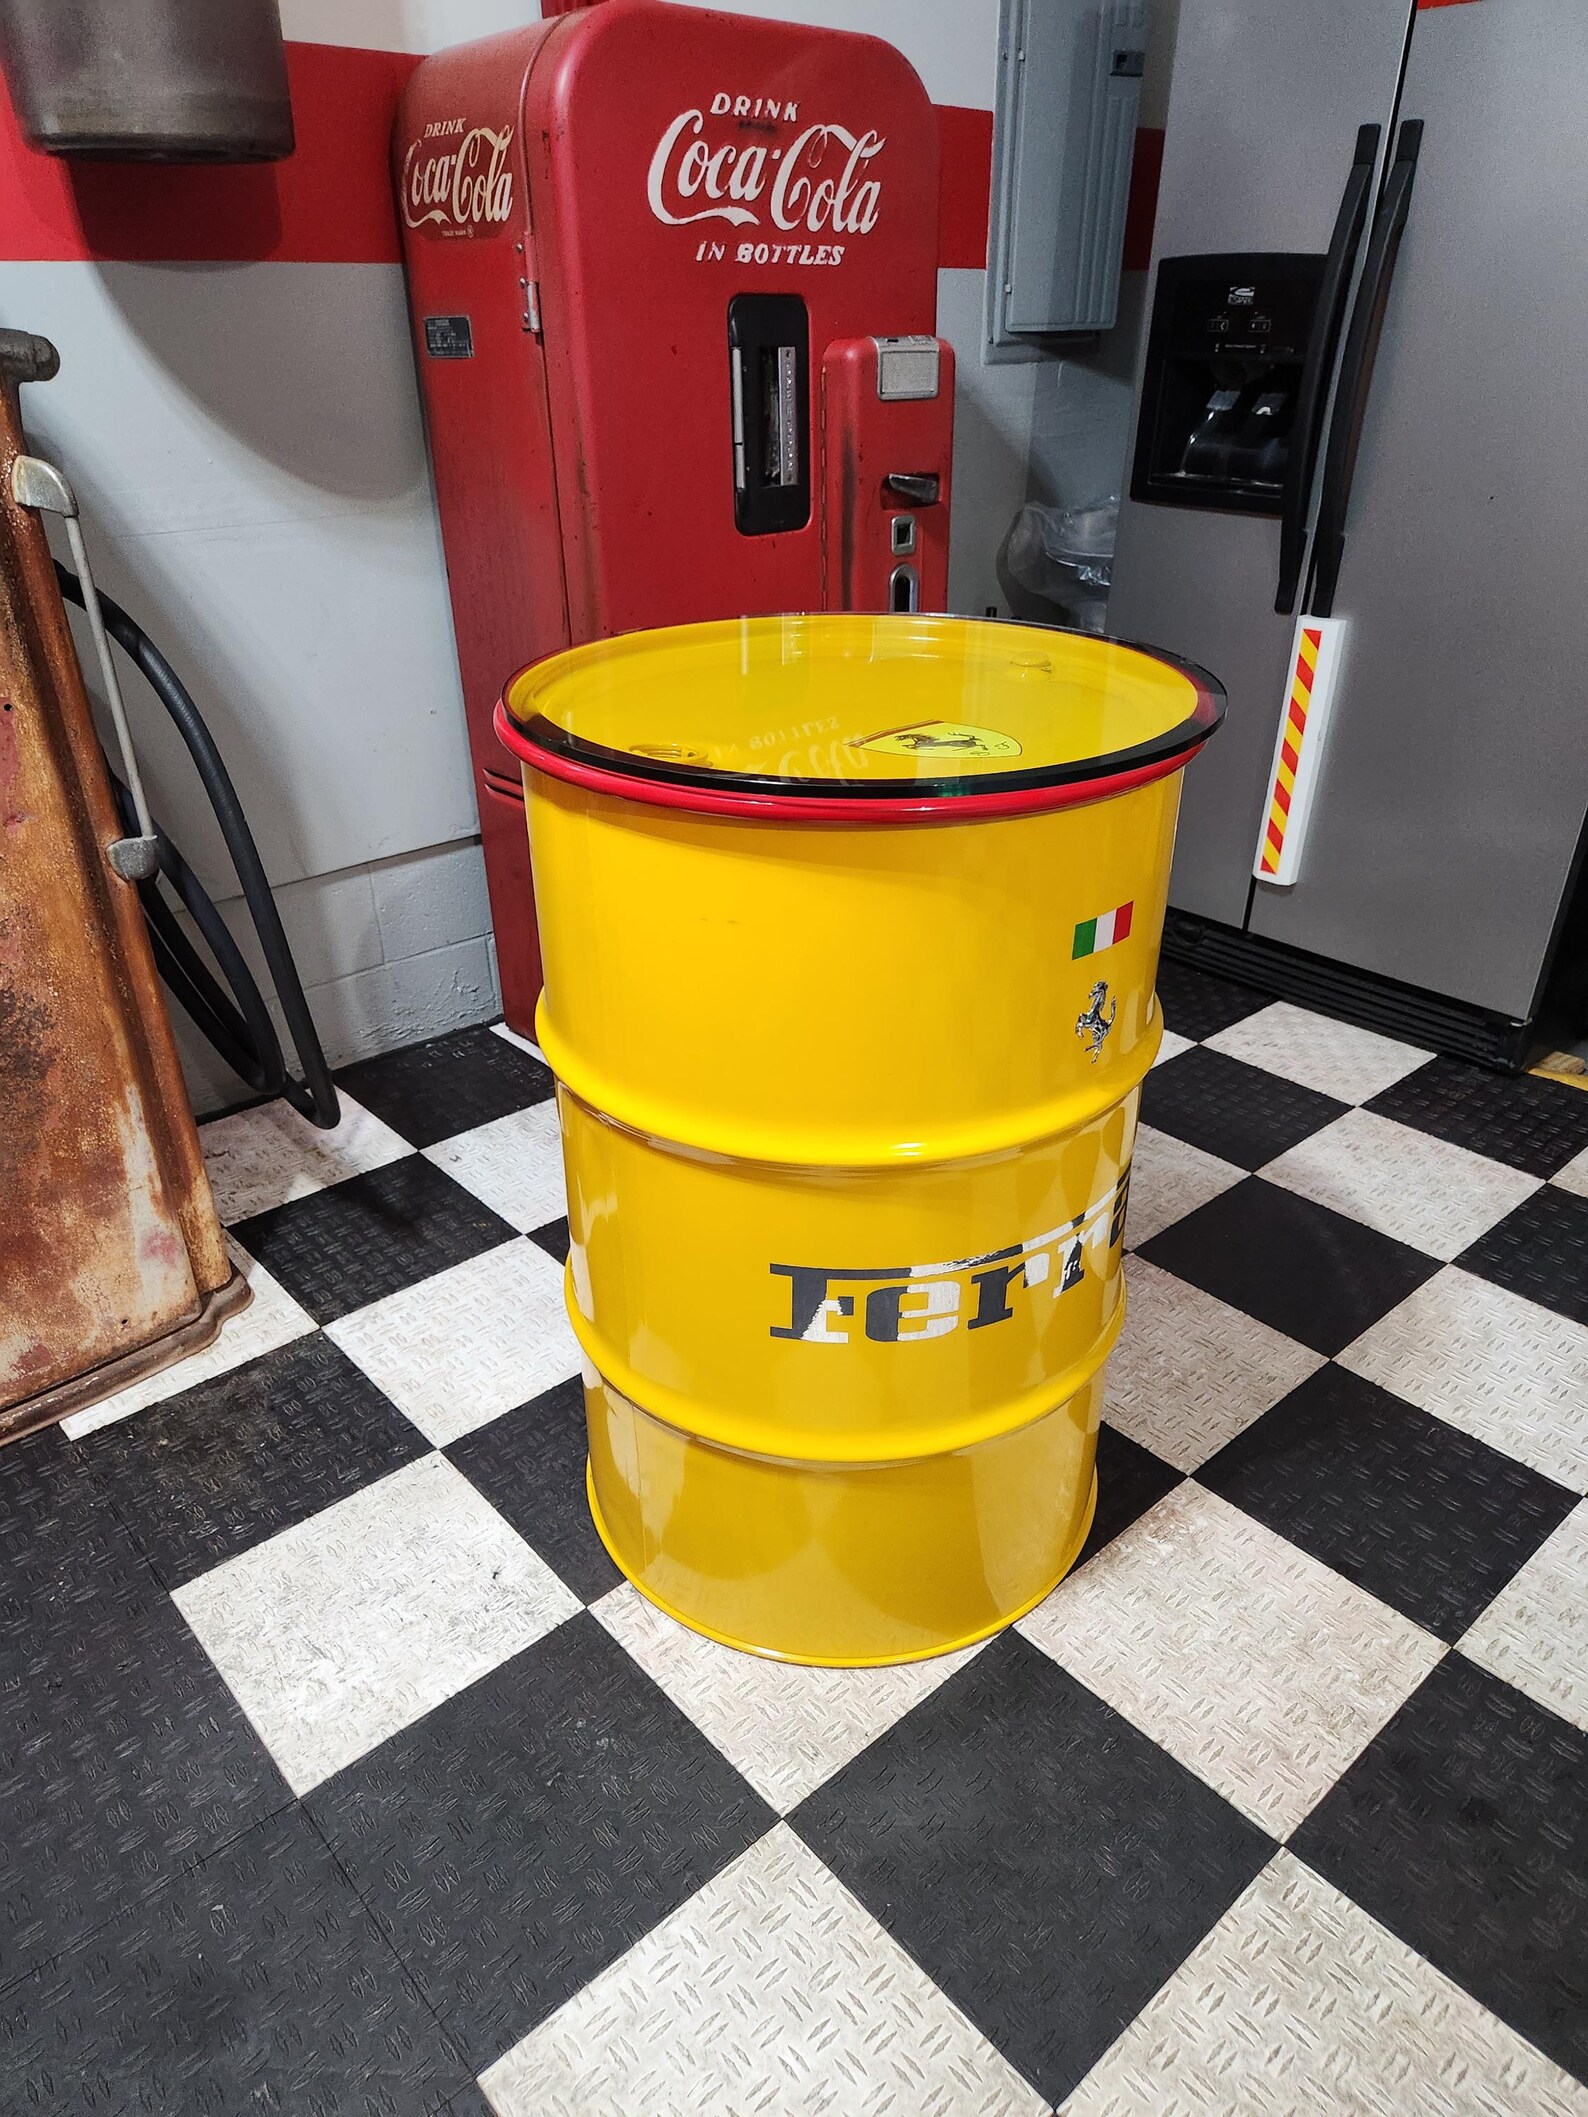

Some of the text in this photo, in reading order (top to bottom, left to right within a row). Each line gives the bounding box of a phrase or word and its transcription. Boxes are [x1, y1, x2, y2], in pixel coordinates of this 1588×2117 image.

[709, 92, 801, 122] DRINK
[423, 117, 467, 139] DRINK
[646, 108, 888, 235] Coca-Cola
[694, 240, 846, 266] IN BOTTLES
